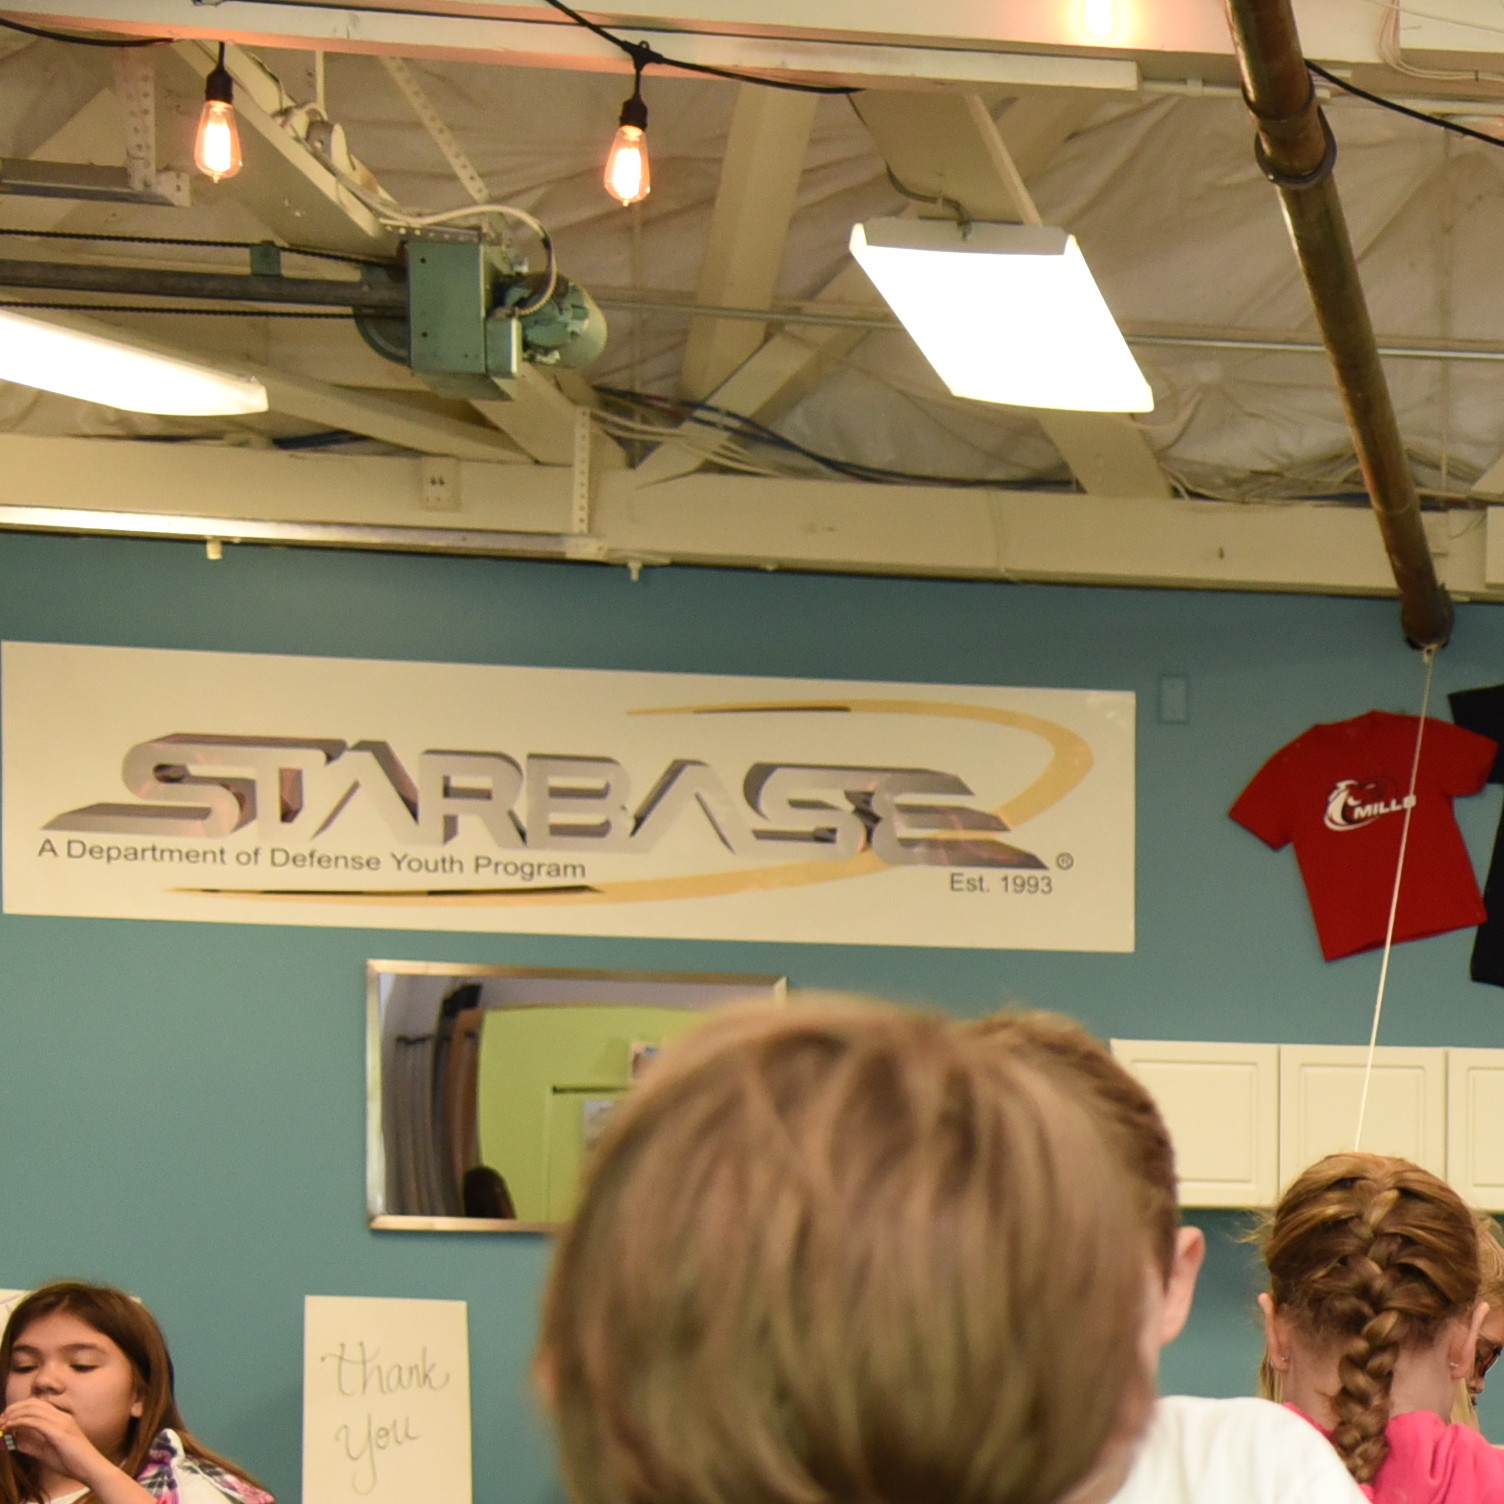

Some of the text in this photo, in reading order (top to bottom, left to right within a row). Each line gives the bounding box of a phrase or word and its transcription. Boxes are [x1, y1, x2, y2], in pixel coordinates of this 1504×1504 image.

[40, 733, 1049, 871] STARBASE
[1353, 795, 1416, 819] MILL
[37, 838, 587, 881] A Department of Defense Youth Program
[950, 873, 1053, 894] Est. 1993
